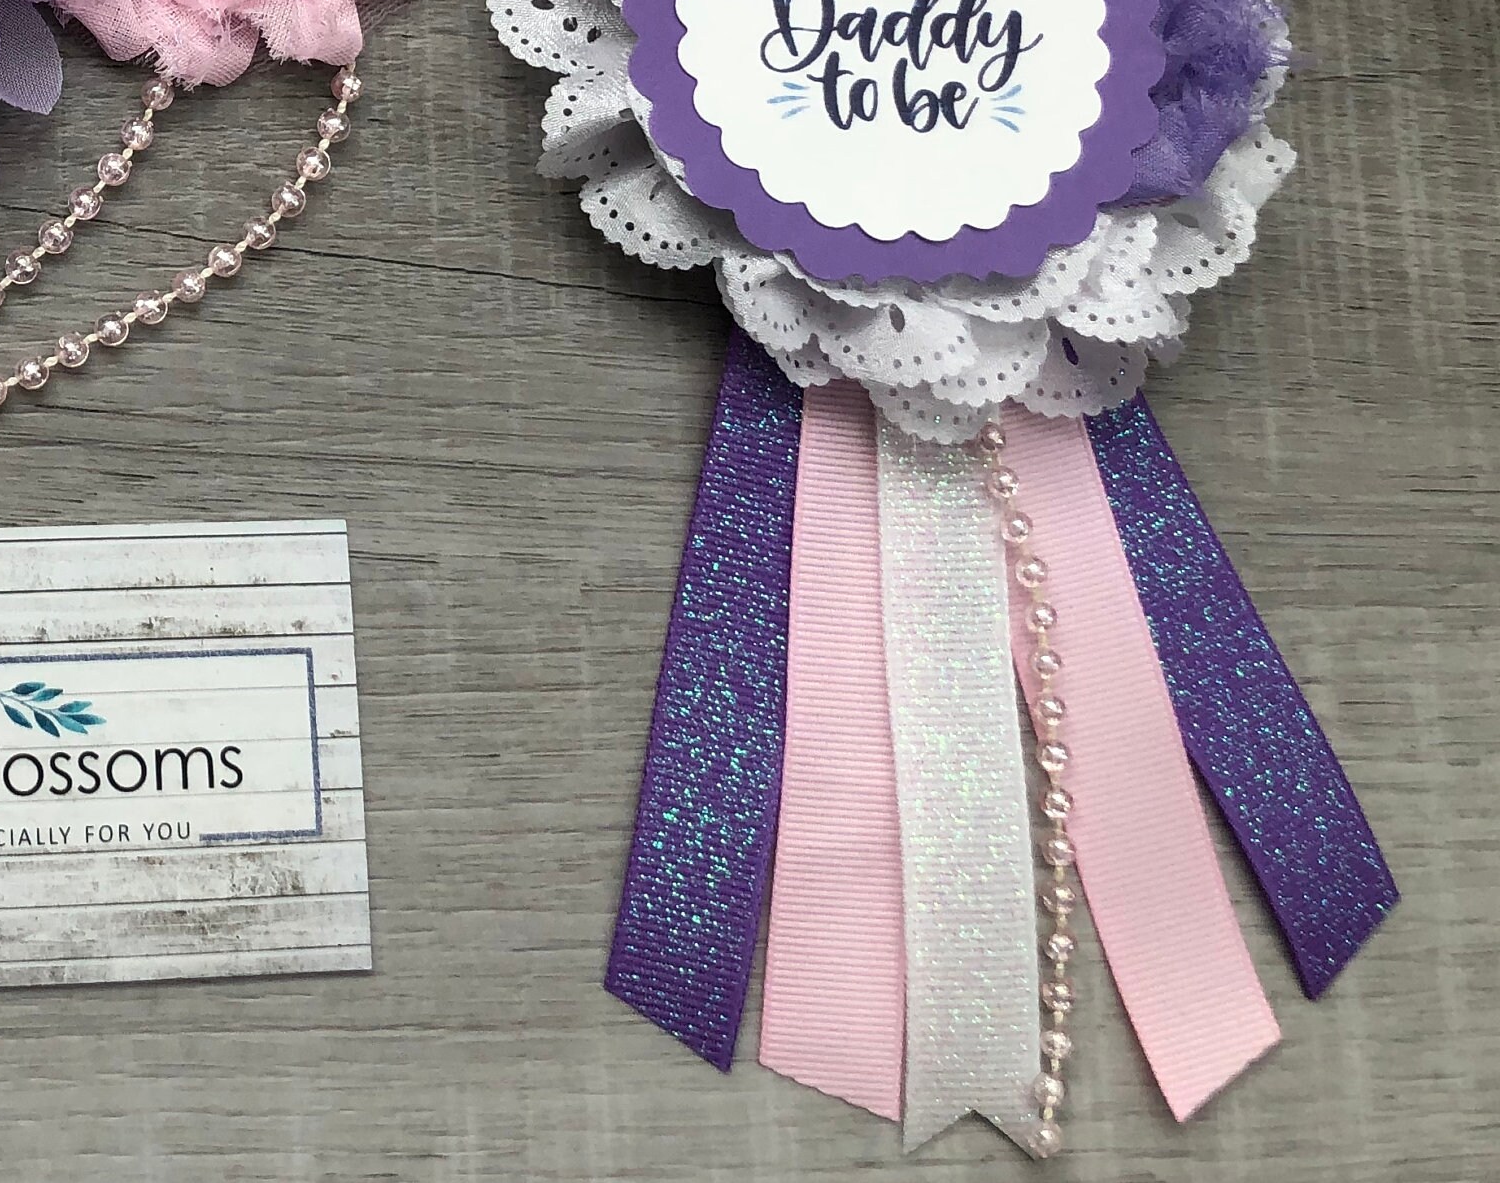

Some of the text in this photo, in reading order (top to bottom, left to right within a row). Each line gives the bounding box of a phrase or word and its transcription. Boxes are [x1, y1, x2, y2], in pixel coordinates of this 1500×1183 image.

[806, 51, 980, 133] to be
[85, 824, 132, 845] FOR
[142, 821, 192, 842] YOU
